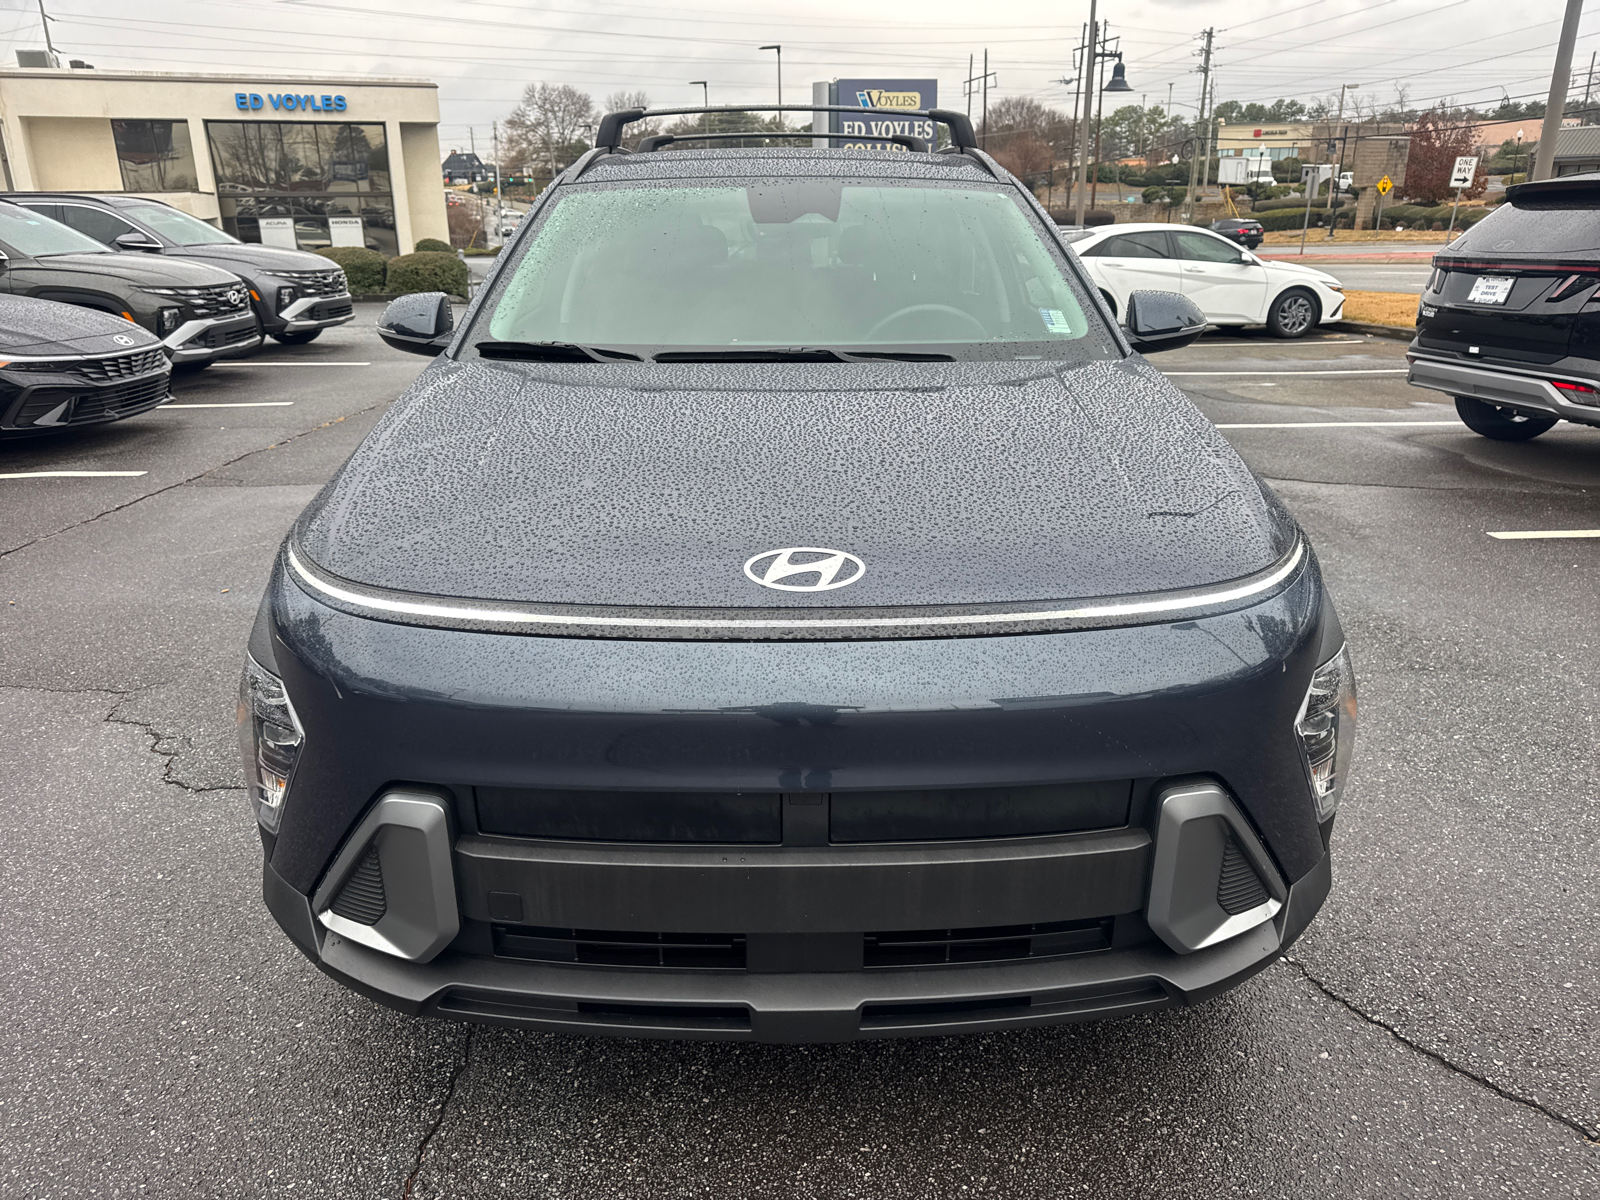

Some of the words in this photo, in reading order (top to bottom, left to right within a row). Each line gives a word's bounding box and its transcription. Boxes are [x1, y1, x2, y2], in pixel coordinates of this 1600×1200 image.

[235, 93, 264, 110] ED
[267, 93, 347, 111] VOYLES
[866, 91, 917, 107] VOYLES
[843, 121, 866, 135] ED
[870, 121, 934, 139] VOYLES
